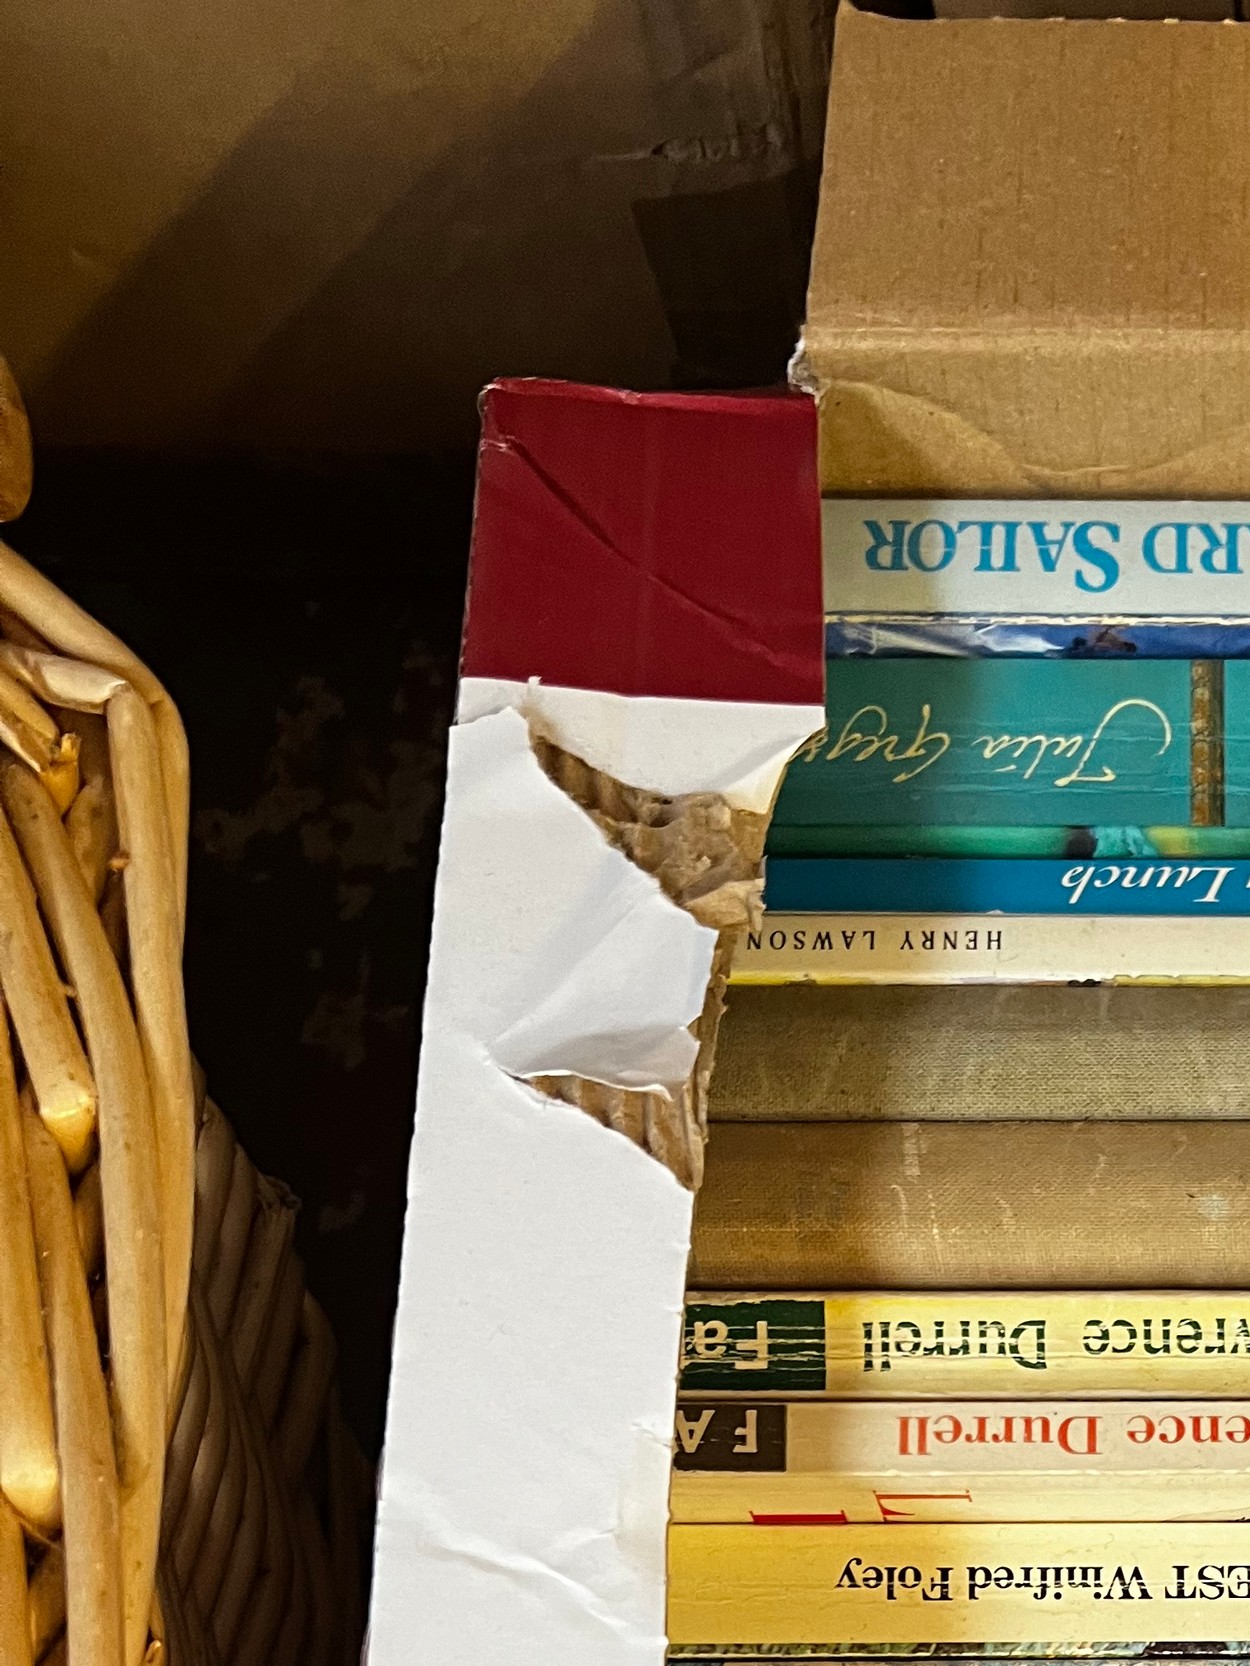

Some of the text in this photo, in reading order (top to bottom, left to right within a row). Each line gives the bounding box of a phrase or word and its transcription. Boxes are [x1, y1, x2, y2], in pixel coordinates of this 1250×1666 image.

[863, 517, 1121, 594] SAILOR
[970, 699, 1172, 788] Julia
[1059, 864, 1232, 908] Lunch
[746, 930, 1003, 951] HENRY LAWSON
[679, 1320, 769, 1371] Fa
[861, 1317, 1049, 1373] Durrell
[896, 1414, 1105, 1458] Durrell
[832, 1556, 956, 1600] Foley
[966, 1558, 1151, 1602] Winifred
